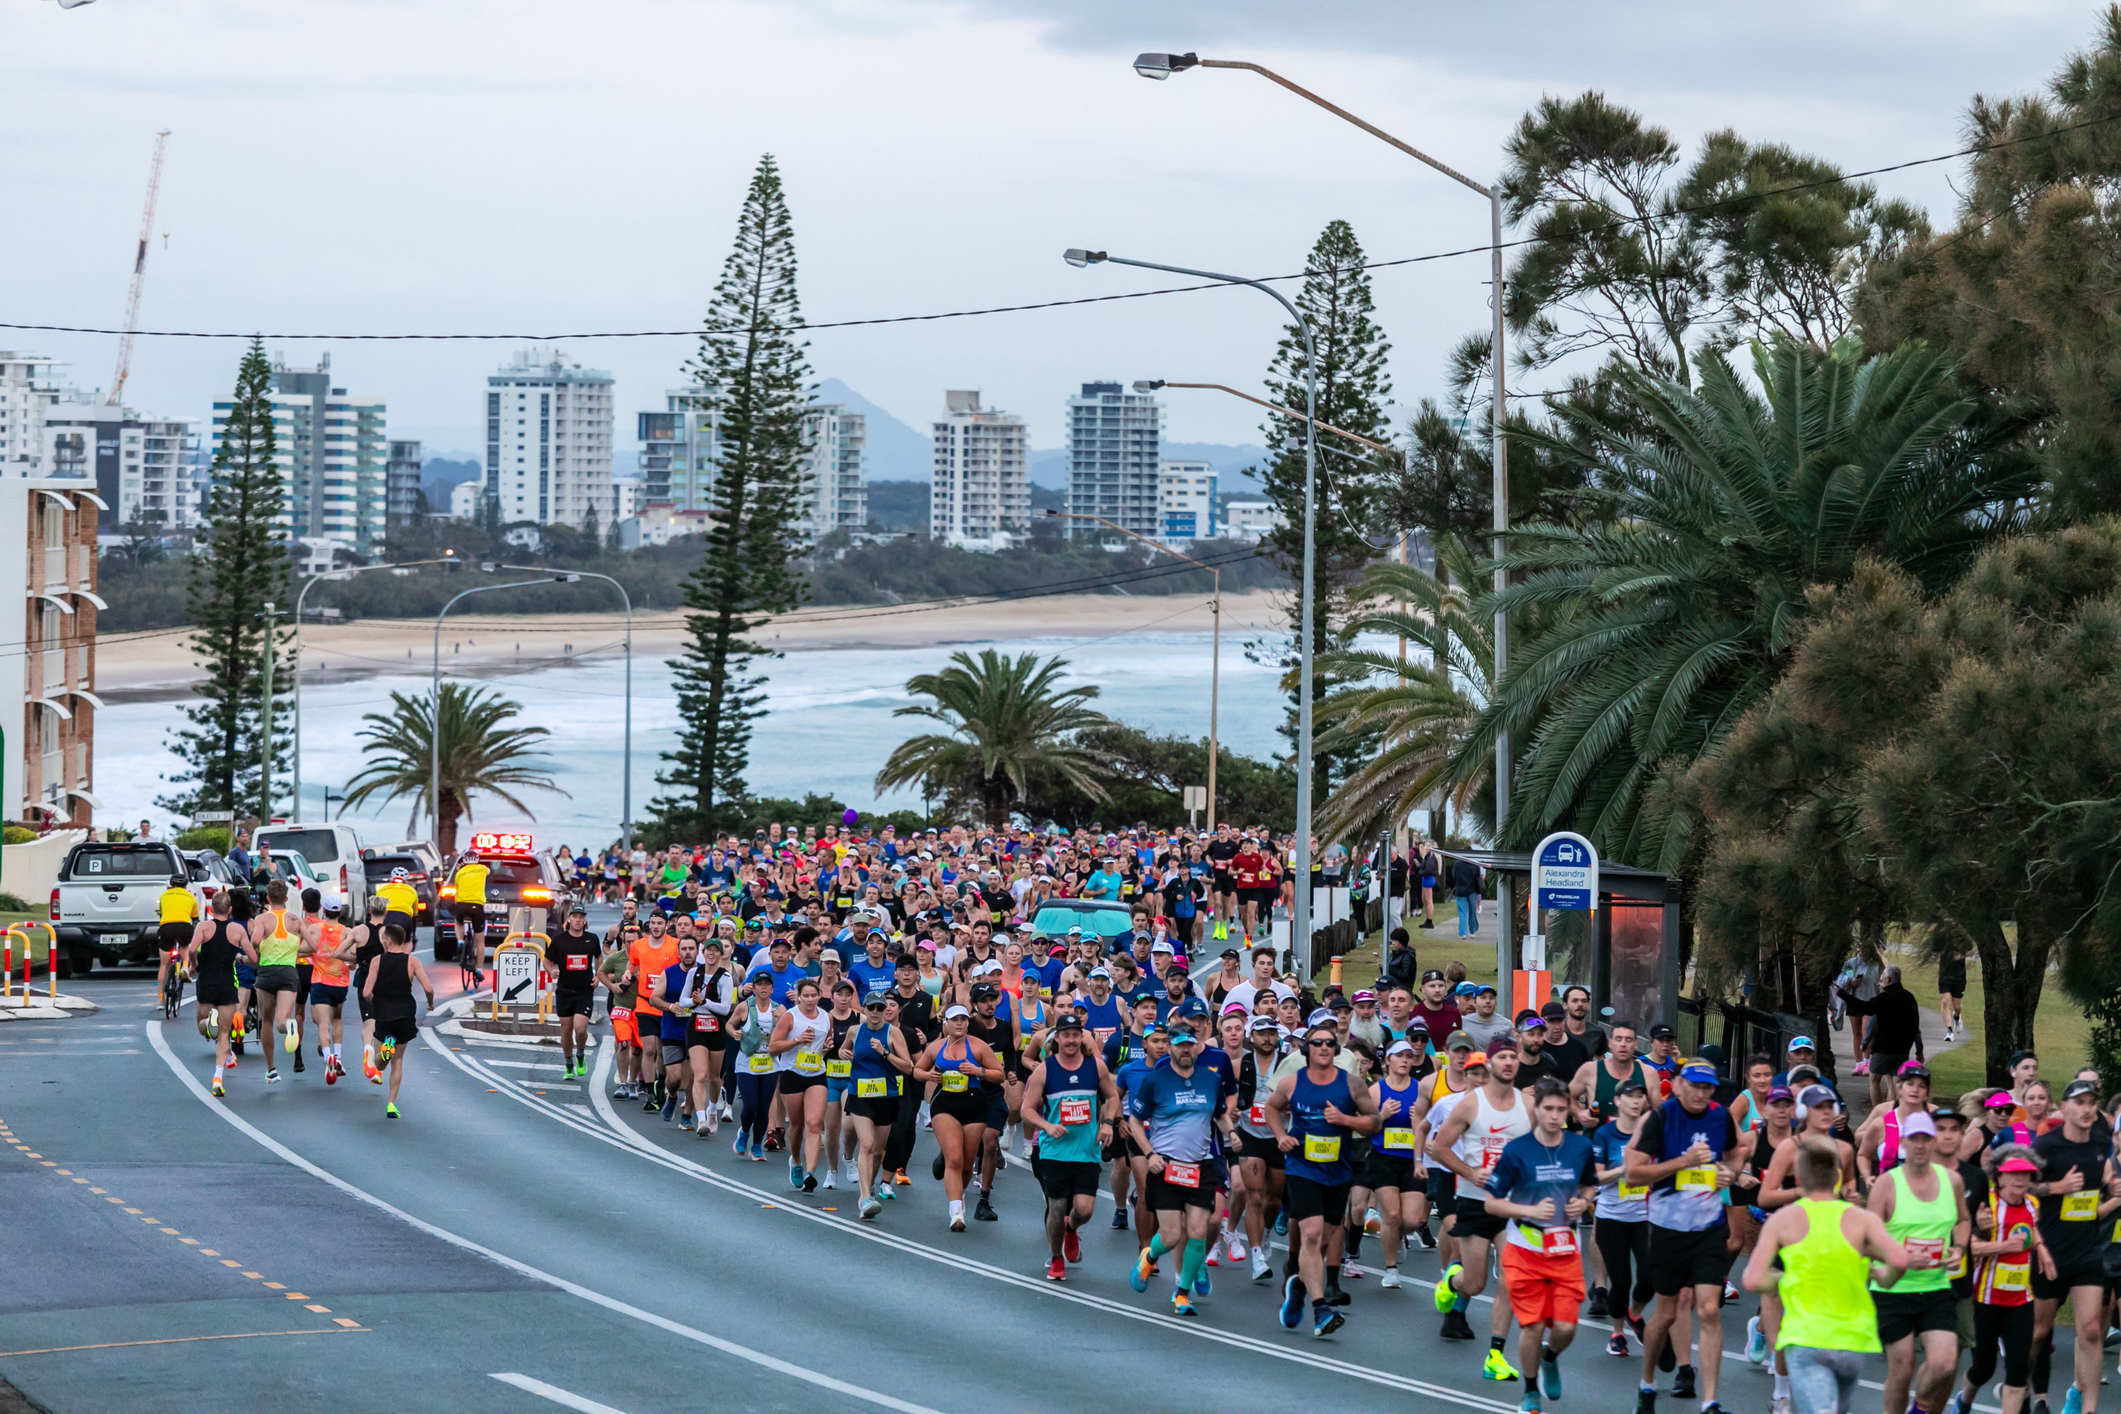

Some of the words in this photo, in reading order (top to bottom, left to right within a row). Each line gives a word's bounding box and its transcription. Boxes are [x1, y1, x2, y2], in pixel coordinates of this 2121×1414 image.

[91, 861, 100, 870] P
[1545, 869, 1585, 878] Alexandra
[1545, 879, 1584, 887] Headland
[504, 956, 531, 966] KEEP
[505, 967, 529, 977] LEFT
